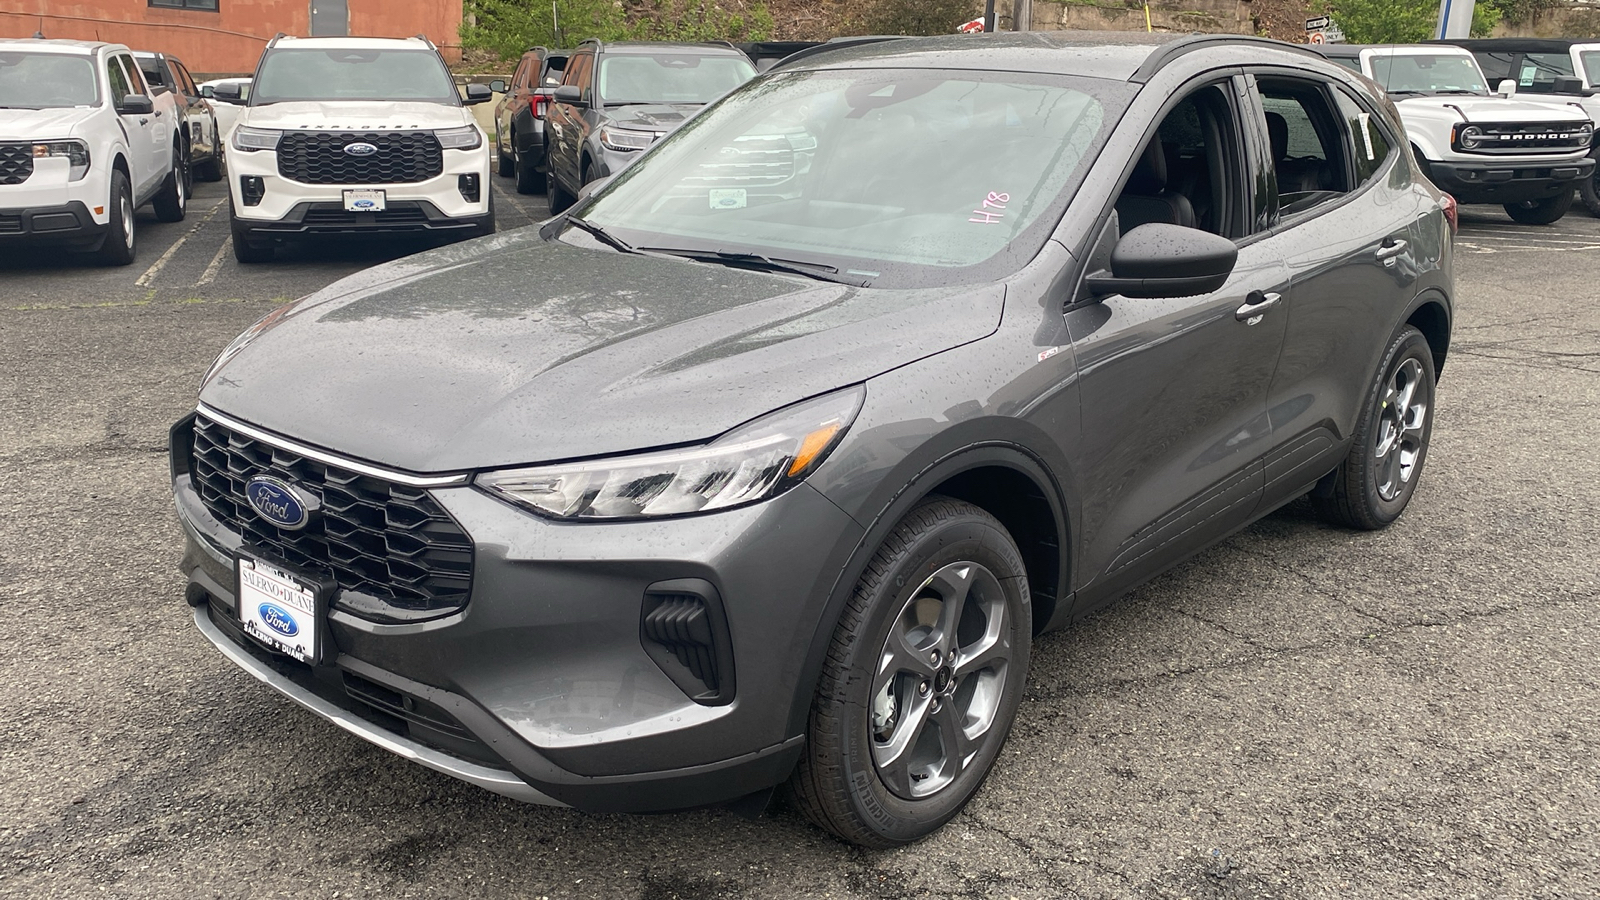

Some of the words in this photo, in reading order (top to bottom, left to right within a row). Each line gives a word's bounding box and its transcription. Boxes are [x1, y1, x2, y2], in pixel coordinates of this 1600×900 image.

[255, 485, 290, 520] Ford
[242, 570, 279, 598] SALERNO
[283, 588, 314, 613] DUANE
[1002, 546, 1028, 600] MICHELIN
[265, 606, 291, 633] Ford
[243, 623, 273, 645] SALERNO
[281, 643, 305, 663] DUANE
[851, 714, 859, 763] PRIMACY
[855, 773, 897, 829] MICHELIN
